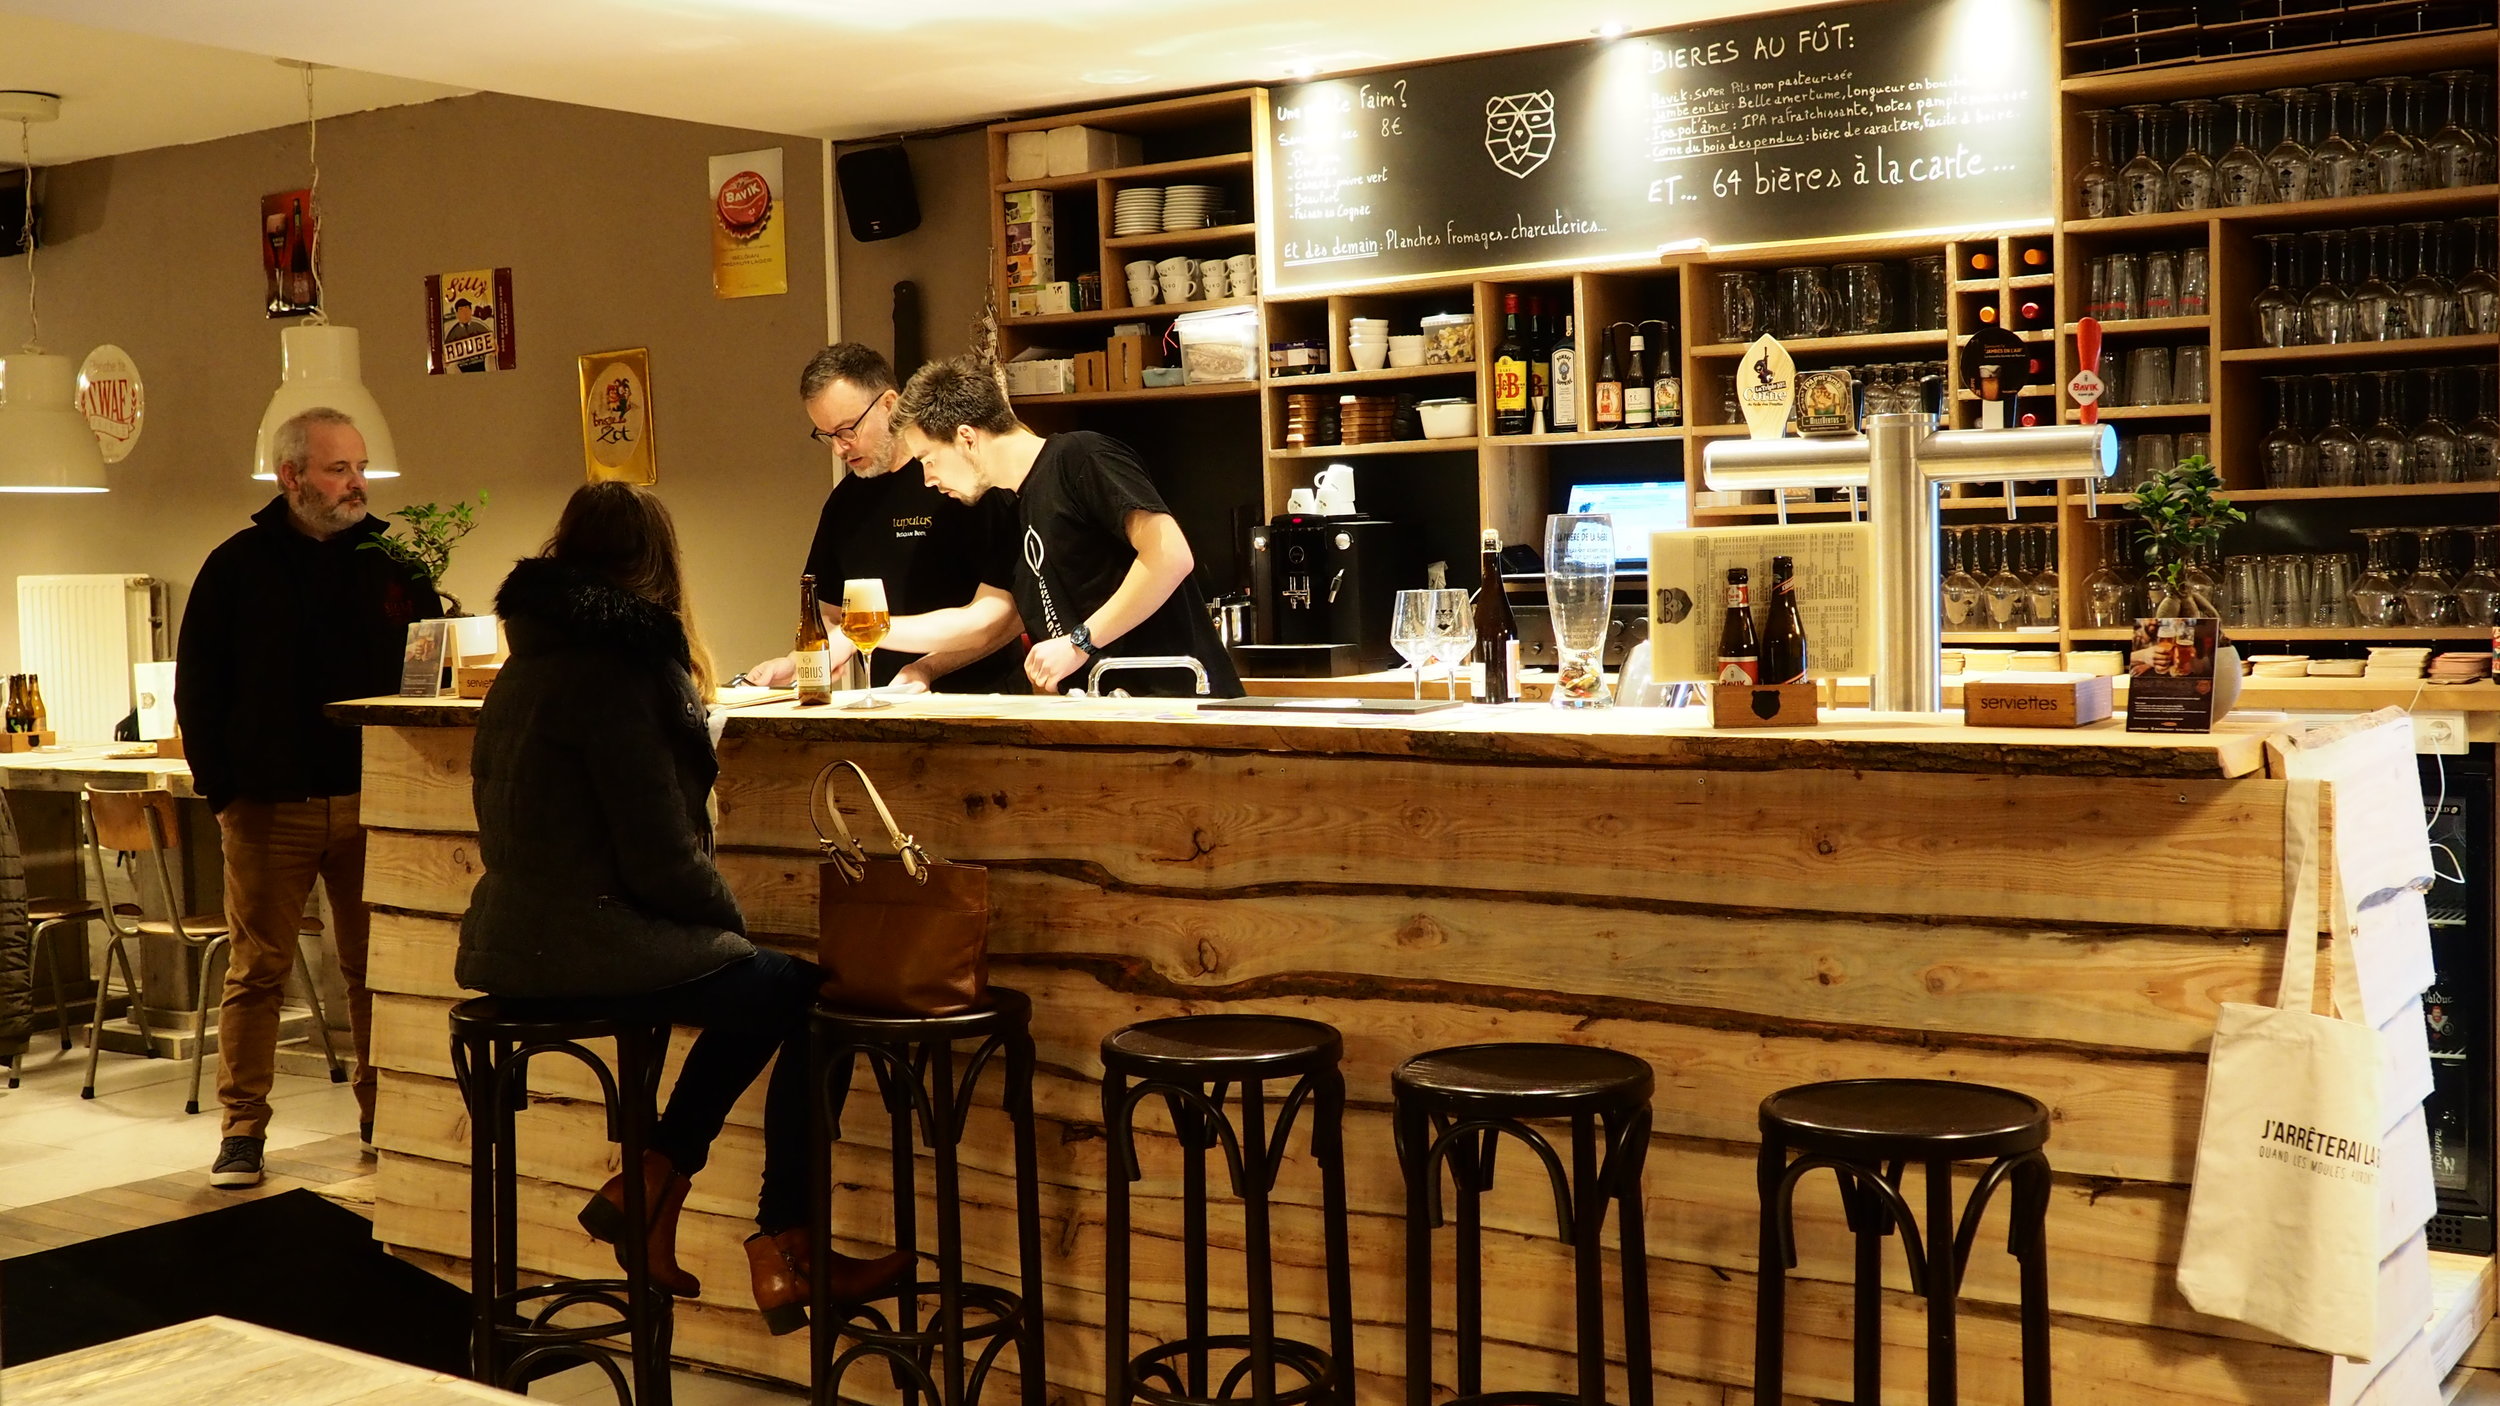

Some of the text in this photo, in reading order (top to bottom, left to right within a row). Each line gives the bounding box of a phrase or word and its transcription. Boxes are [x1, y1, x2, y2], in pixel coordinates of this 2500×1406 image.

[1649, 40, 1740, 74] BIERES
[1754, 36, 1786, 60] AU
[1754, 82, 1774, 91] non
[1778, 69, 1853, 92] pasteurisée
[1692, 105, 1706, 115] en
[1738, 95, 1772, 110] Belle
[1847, 84, 1905, 102] longueur
[1908, 81, 1923, 91] en
[1741, 114, 1767, 130] IPA
[1875, 98, 1912, 114] notes
[1685, 140, 1701, 155] du
[1703, 139, 1726, 154] bois
[1729, 135, 1751, 150] des
[1811, 127, 1841, 142] bière
[1844, 122, 1861, 138] de
[1366, 166, 1388, 183] vert
[1713, 168, 1743, 198] 64
[1755, 161, 1842, 195] bières
[1853, 153, 1870, 185] à
[1877, 145, 1904, 185] la
[1909, 143, 1987, 183] carte
[724, 183, 761, 203] BAVIK
[1336, 204, 1371, 222] Cognac
[1284, 242, 1300, 258] Et
[1305, 239, 1328, 258] dès
[1386, 226, 1441, 250] Planches
[446, 334, 493, 361] ROUGE
[1496, 372, 1520, 399] J&B
[1743, 386, 1788, 402] Corne
[2073, 383, 2099, 391] BAVIK
[597, 425, 635, 444] Zot
[893, 516, 932, 530] lupulus
[1981, 695, 2058, 711] serviettes
[2261, 1119, 2362, 1163] J'ARRÊTERAI
[2364, 1144, 2376, 1168] LA
[2434, 1127, 2442, 1170] HOUPPE
[2259, 1145, 2289, 1163] QUAND
[2292, 1154, 2308, 1169] LES
[2310, 1160, 2346, 1180] MOULES
